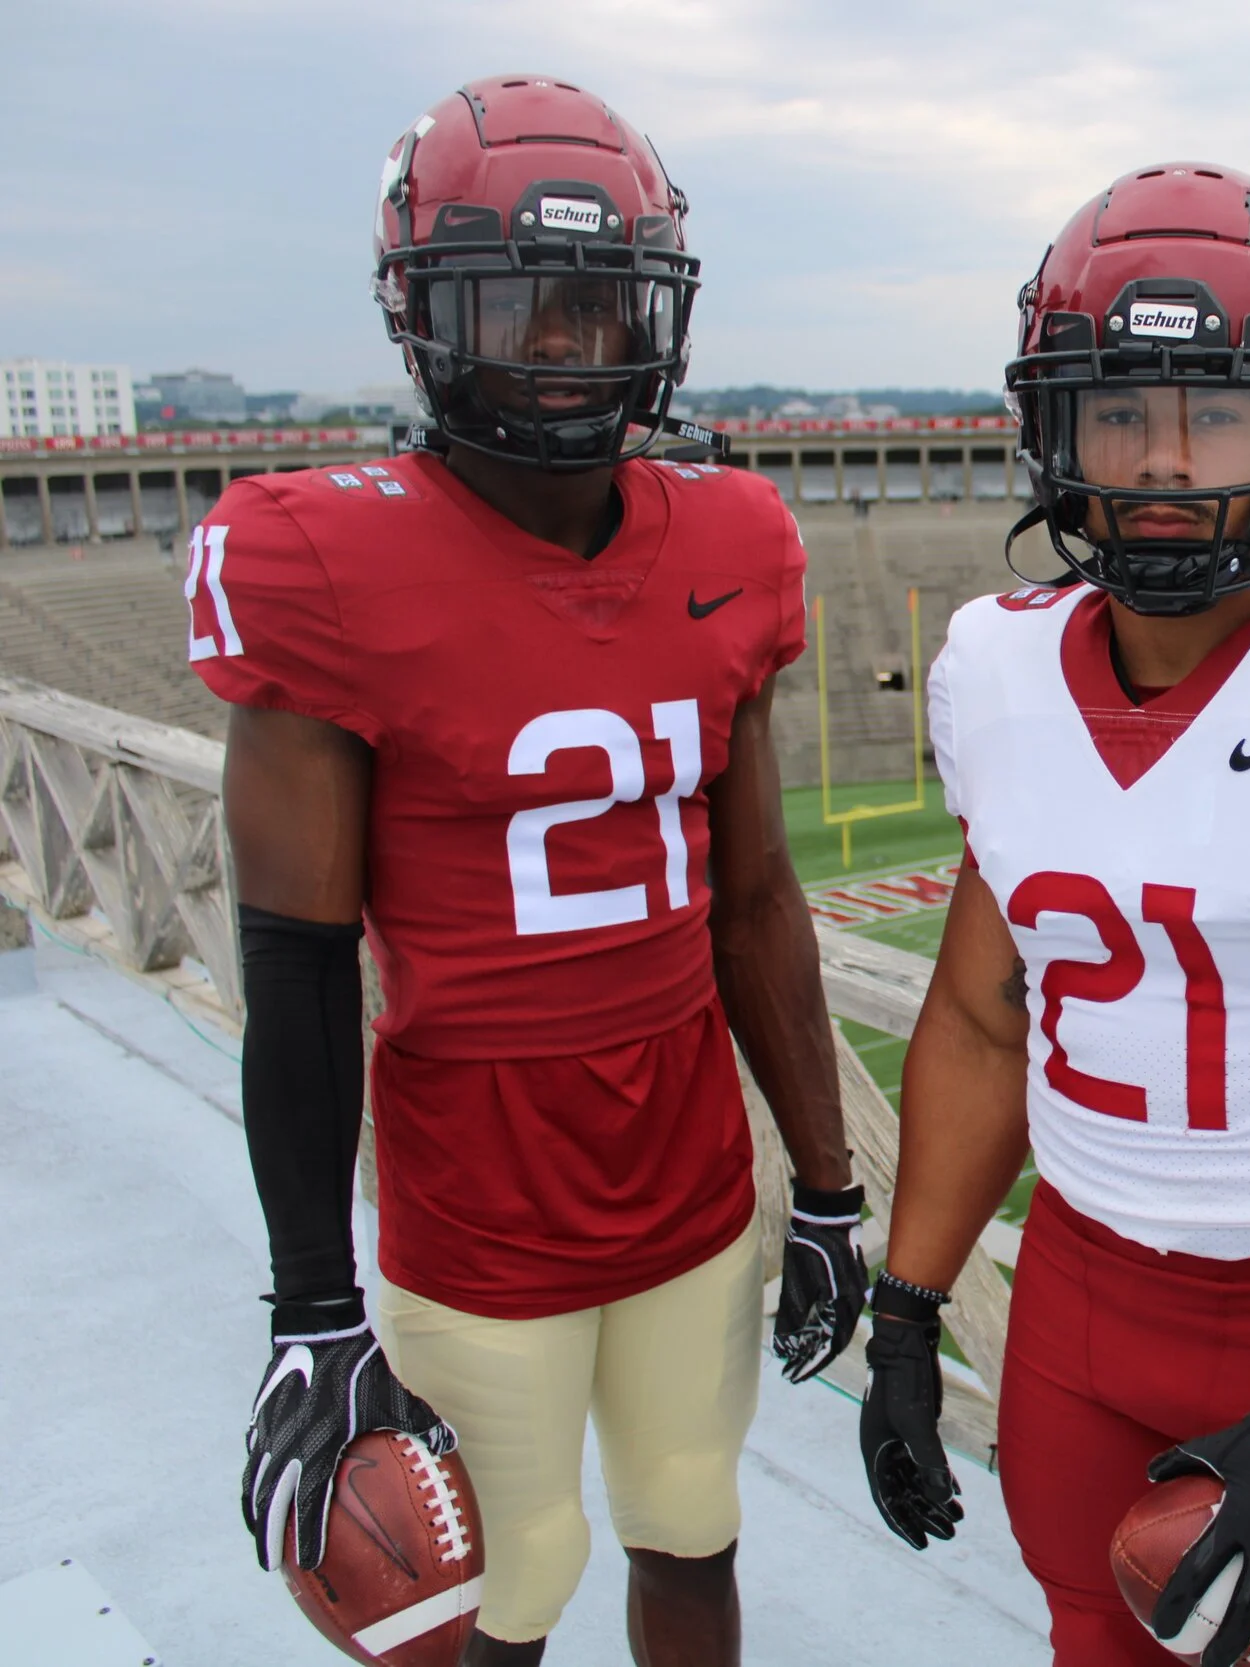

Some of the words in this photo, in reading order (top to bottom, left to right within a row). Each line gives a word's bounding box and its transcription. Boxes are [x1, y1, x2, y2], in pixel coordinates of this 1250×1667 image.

[543, 206, 600, 225] schutt
[1132, 310, 1196, 330] schutt
[678, 423, 714, 446] schutt
[506, 698, 702, 935] 21
[1007, 870, 1228, 1131] 21
